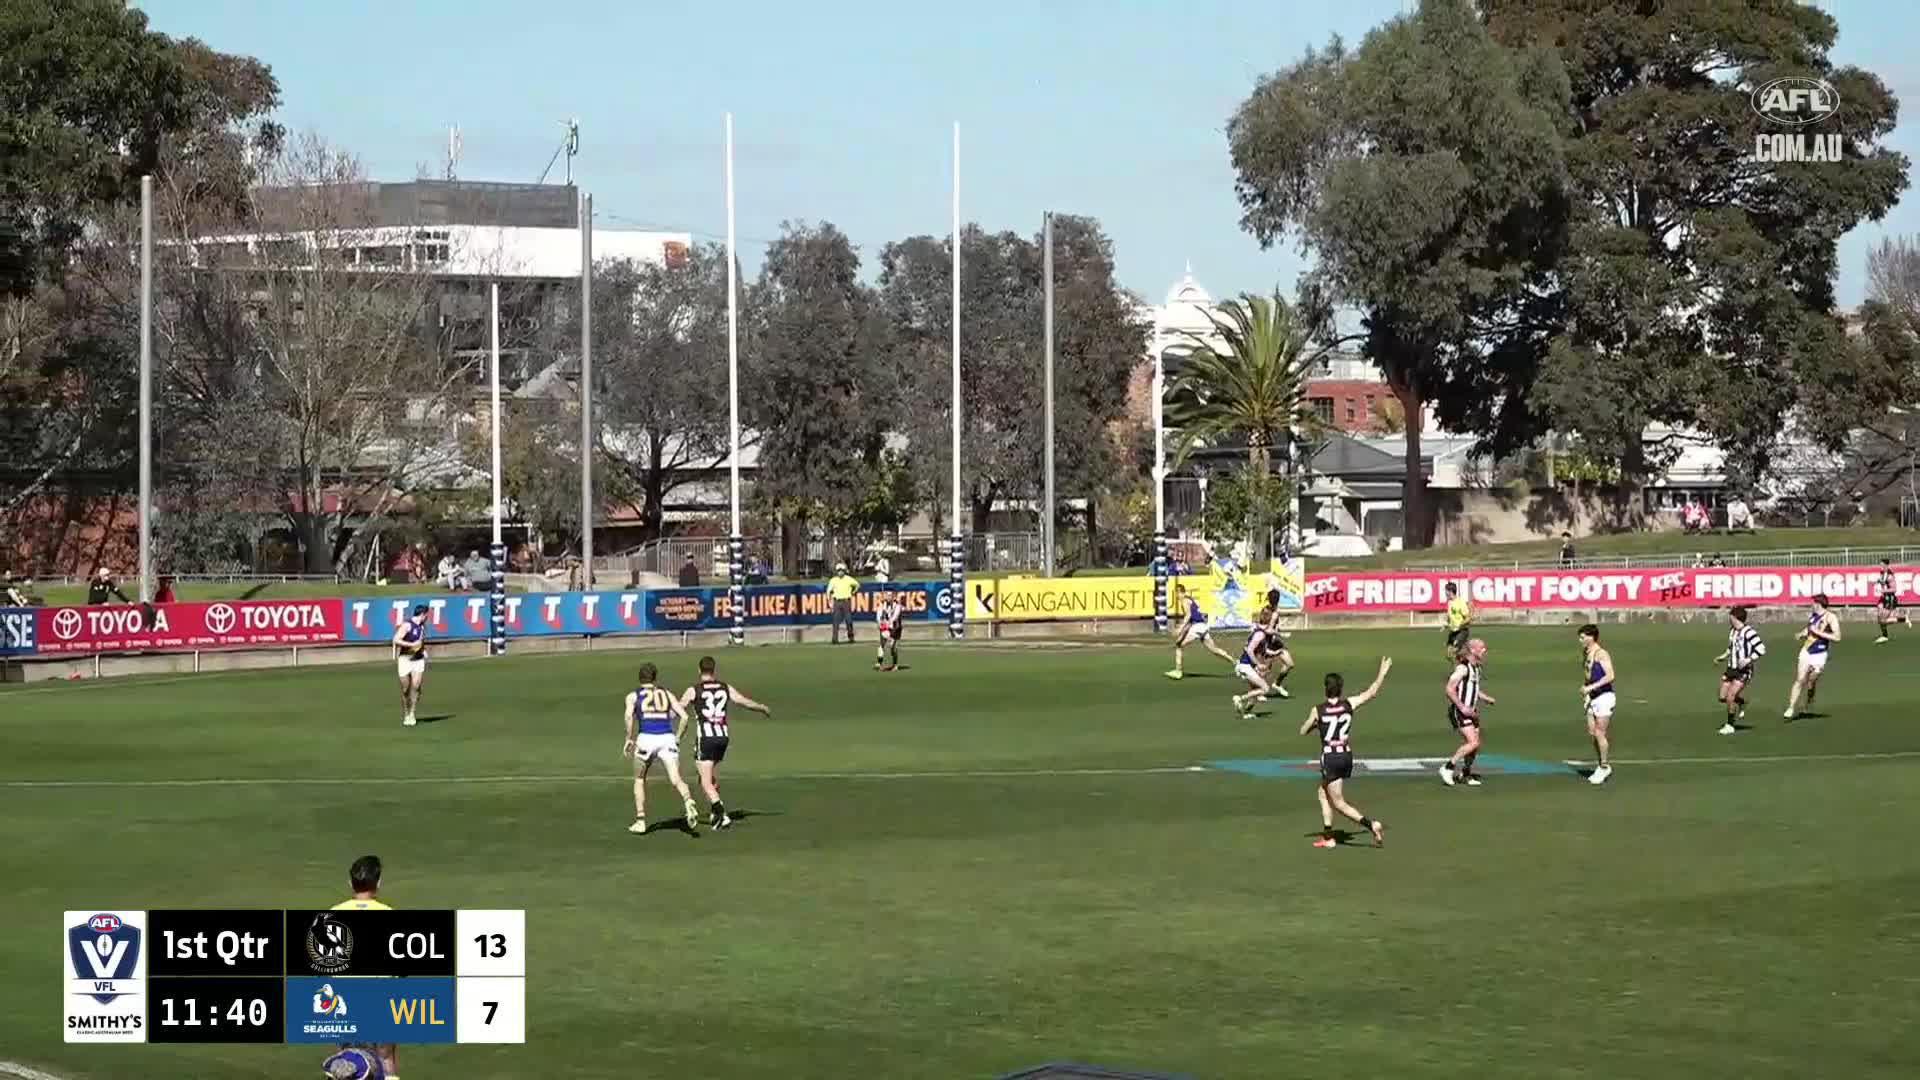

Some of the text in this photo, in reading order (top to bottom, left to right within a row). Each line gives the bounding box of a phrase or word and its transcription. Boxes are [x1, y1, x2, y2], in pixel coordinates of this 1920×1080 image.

[1305, 577, 1339, 596] KFC
[1347, 575, 1643, 604] FRIED NIGHT FOOTY
[1650, 573, 1686, 591] KFC
[1695, 574, 1784, 599] FRIED
[1790, 573, 1889, 597] NIGHT
[713, 596, 749, 618] FEL
[751, 594, 785, 616] LIKE
[790, 595, 798, 616] A
[872, 591, 926, 612] BCKS
[1000, 590, 1088, 614] KANGAN
[1314, 590, 1345, 608] FLG
[1660, 587, 1692, 602] FLG
[88, 609, 169, 635] TOYOA
[241, 606, 325, 629] TOYOTA
[640, 689, 668, 712] 20
[701, 689, 727, 716] 32
[1321, 713, 1352, 741] 72
